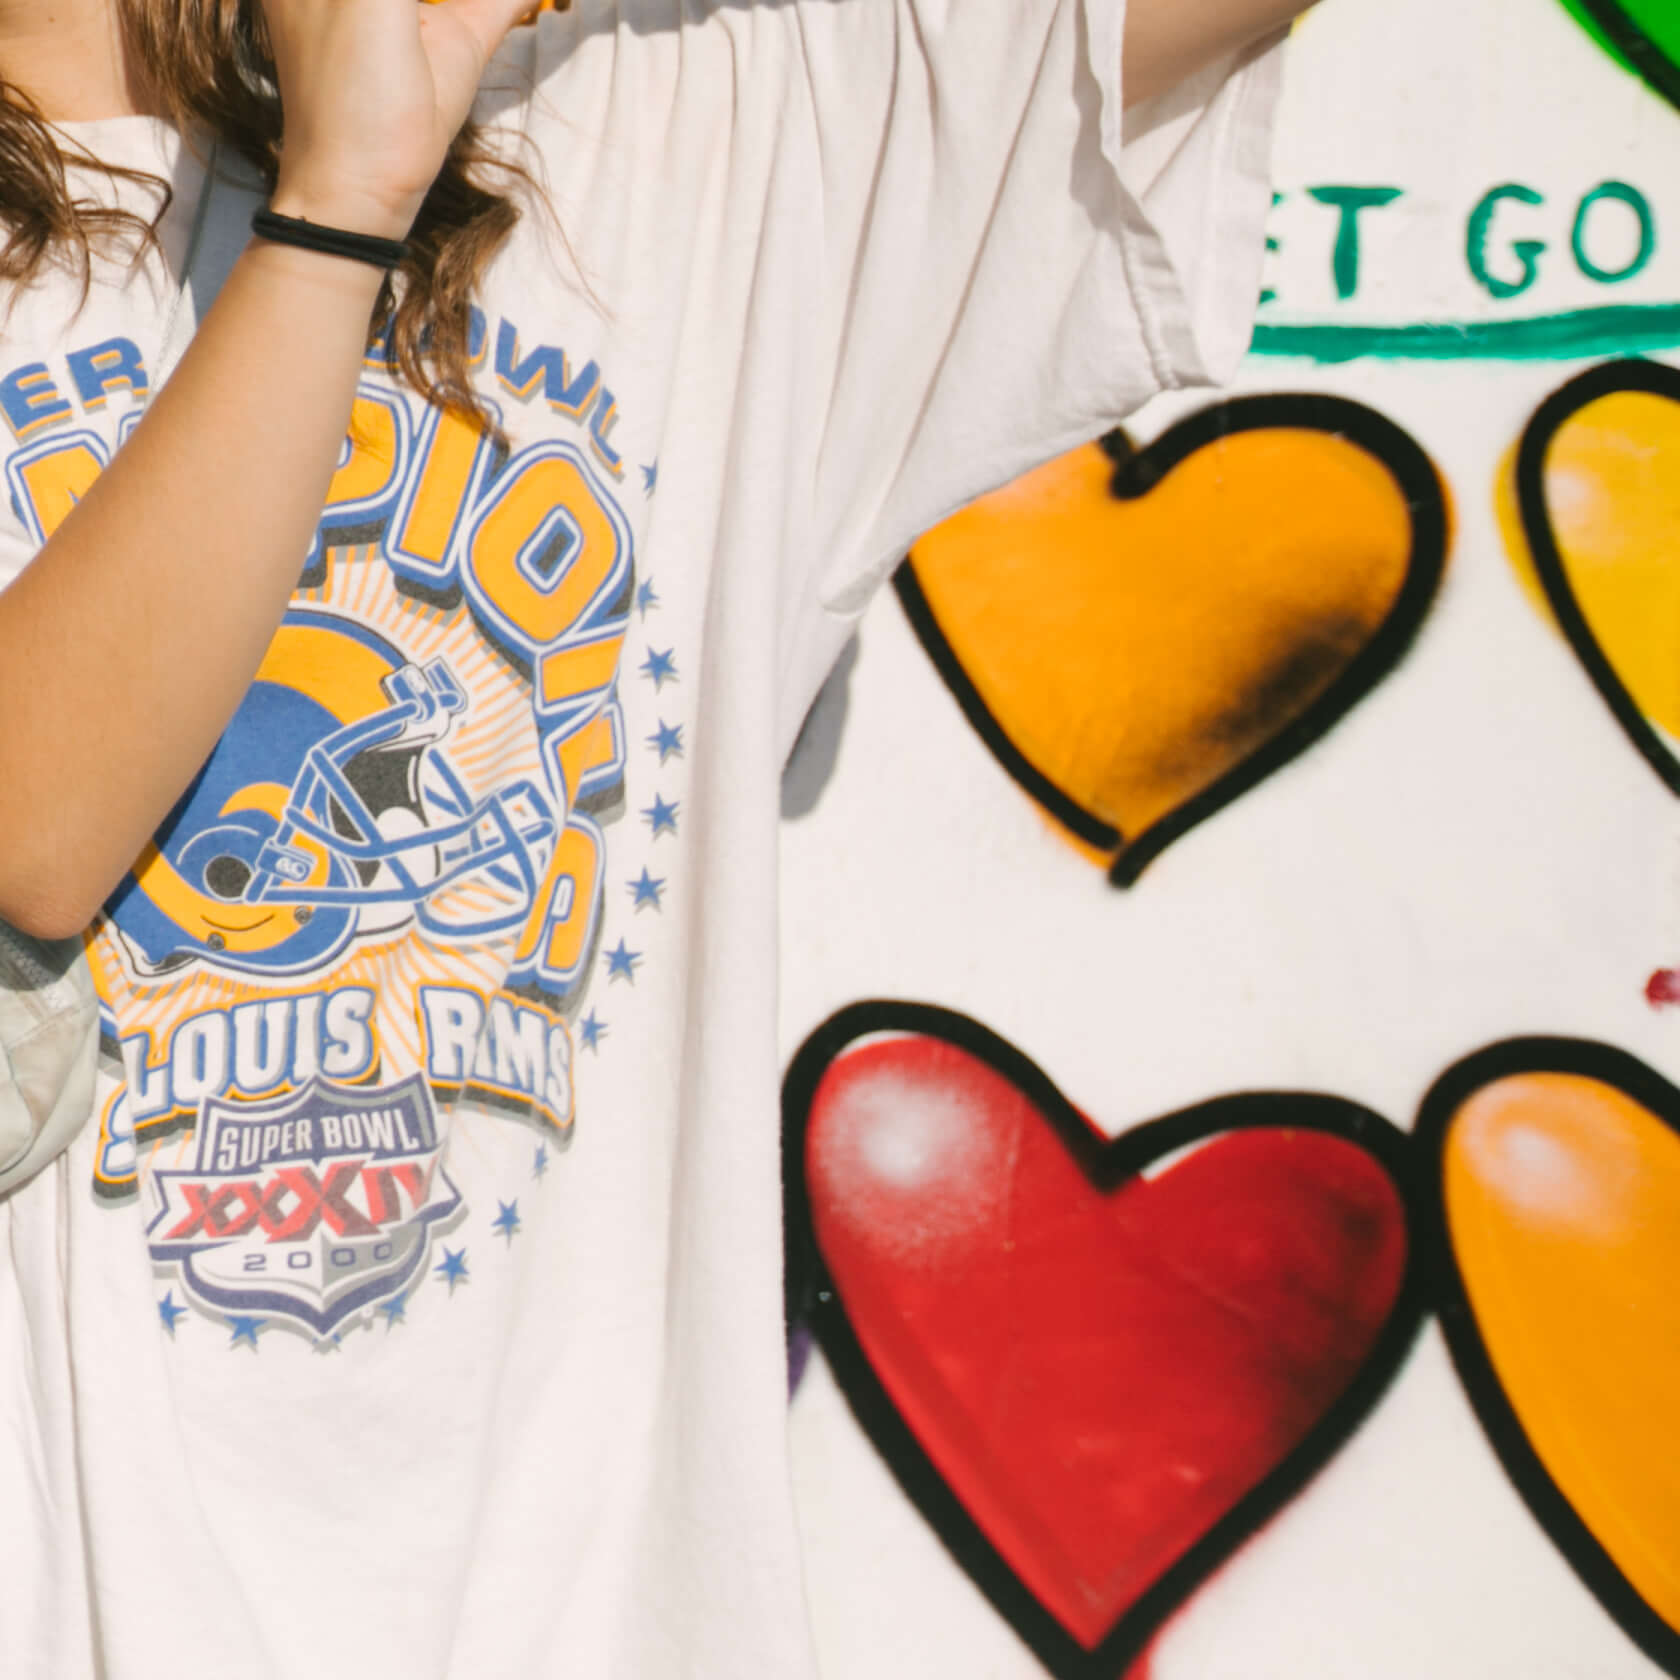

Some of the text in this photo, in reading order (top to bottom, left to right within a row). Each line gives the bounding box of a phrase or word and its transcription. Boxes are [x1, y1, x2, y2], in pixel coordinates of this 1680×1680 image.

[1259, 180, 1657, 305] T GO
[122, 984, 382, 1132] LOUIS
[216, 1107, 420, 1172] SUPER BOWL
[242, 1241, 393, 1272] 2000
